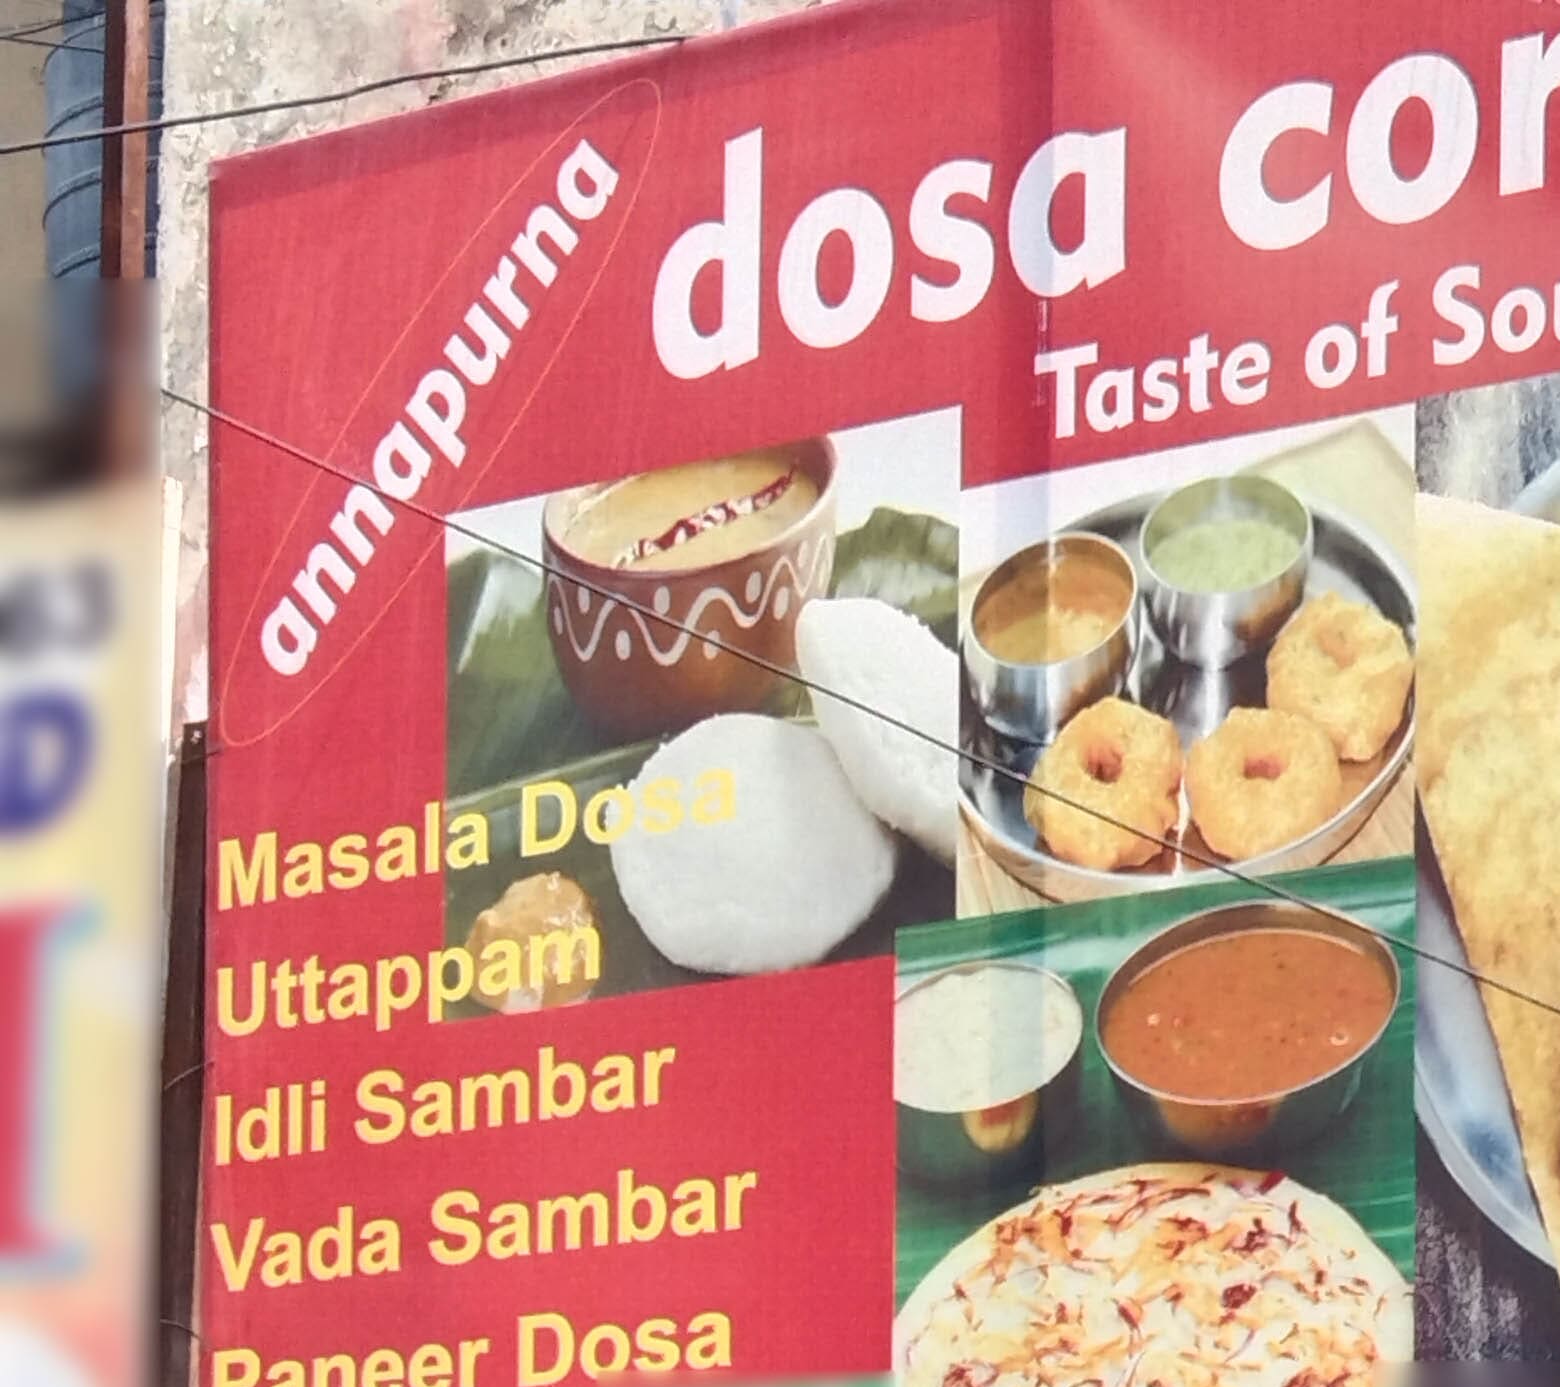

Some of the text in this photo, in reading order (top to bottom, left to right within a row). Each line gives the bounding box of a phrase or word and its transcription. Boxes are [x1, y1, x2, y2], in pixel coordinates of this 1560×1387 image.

[651, 127, 1127, 380] dosa
[259, 139, 620, 677] annapurna
[1034, 333, 1270, 439] Taste
[1304, 279, 1398, 390] of
[217, 765, 736, 911] Masala Dosa
[216, 923, 601, 1037] Uttappam
[215, 1046, 676, 1165] Idli Sambar
[210, 1168, 757, 1293] Vada Sambar
[518, 1310, 733, 1387] Dosa
